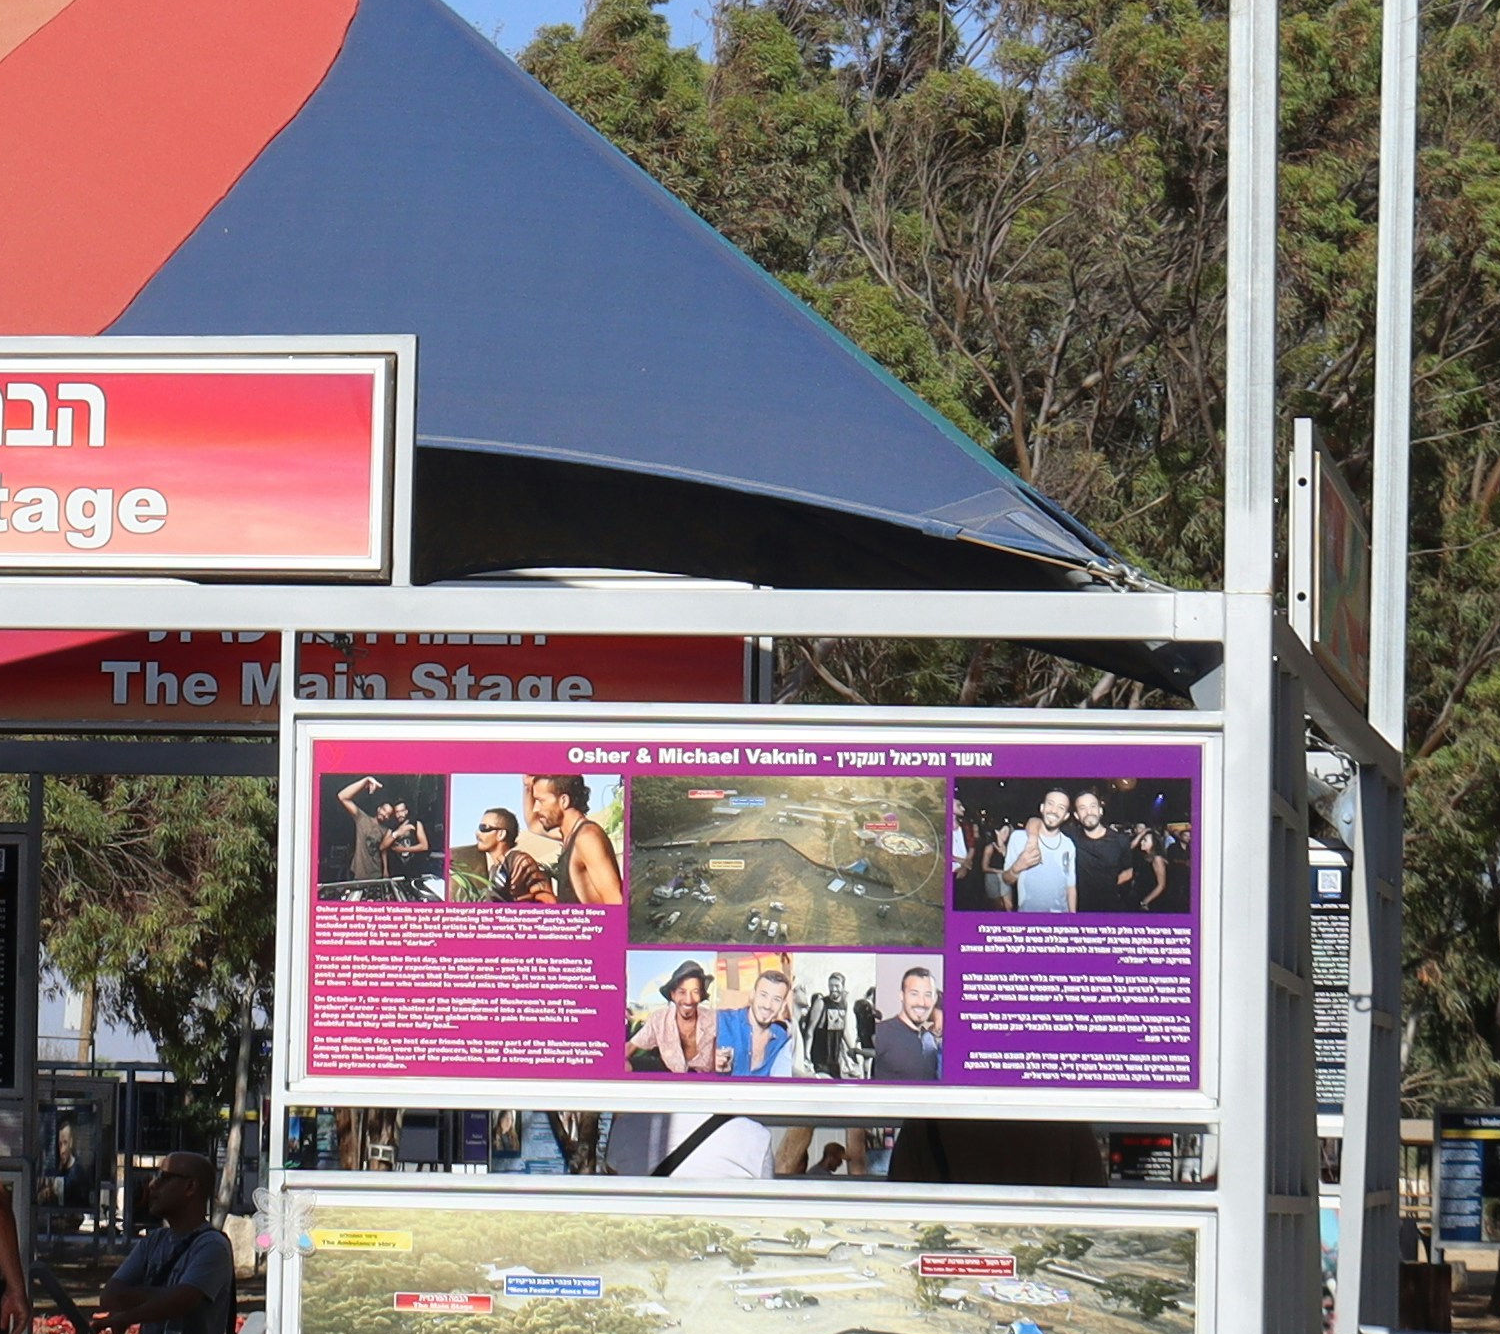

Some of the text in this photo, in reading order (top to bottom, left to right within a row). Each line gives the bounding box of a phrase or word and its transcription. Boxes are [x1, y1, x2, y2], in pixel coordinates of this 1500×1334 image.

[101, 661, 217, 707] The
[409, 663, 594, 701] Stage
[568, 747, 816, 764] Osher & Michael Vaknin
[836, 749, 992, 767] אושר ומיכאל ועקנין
